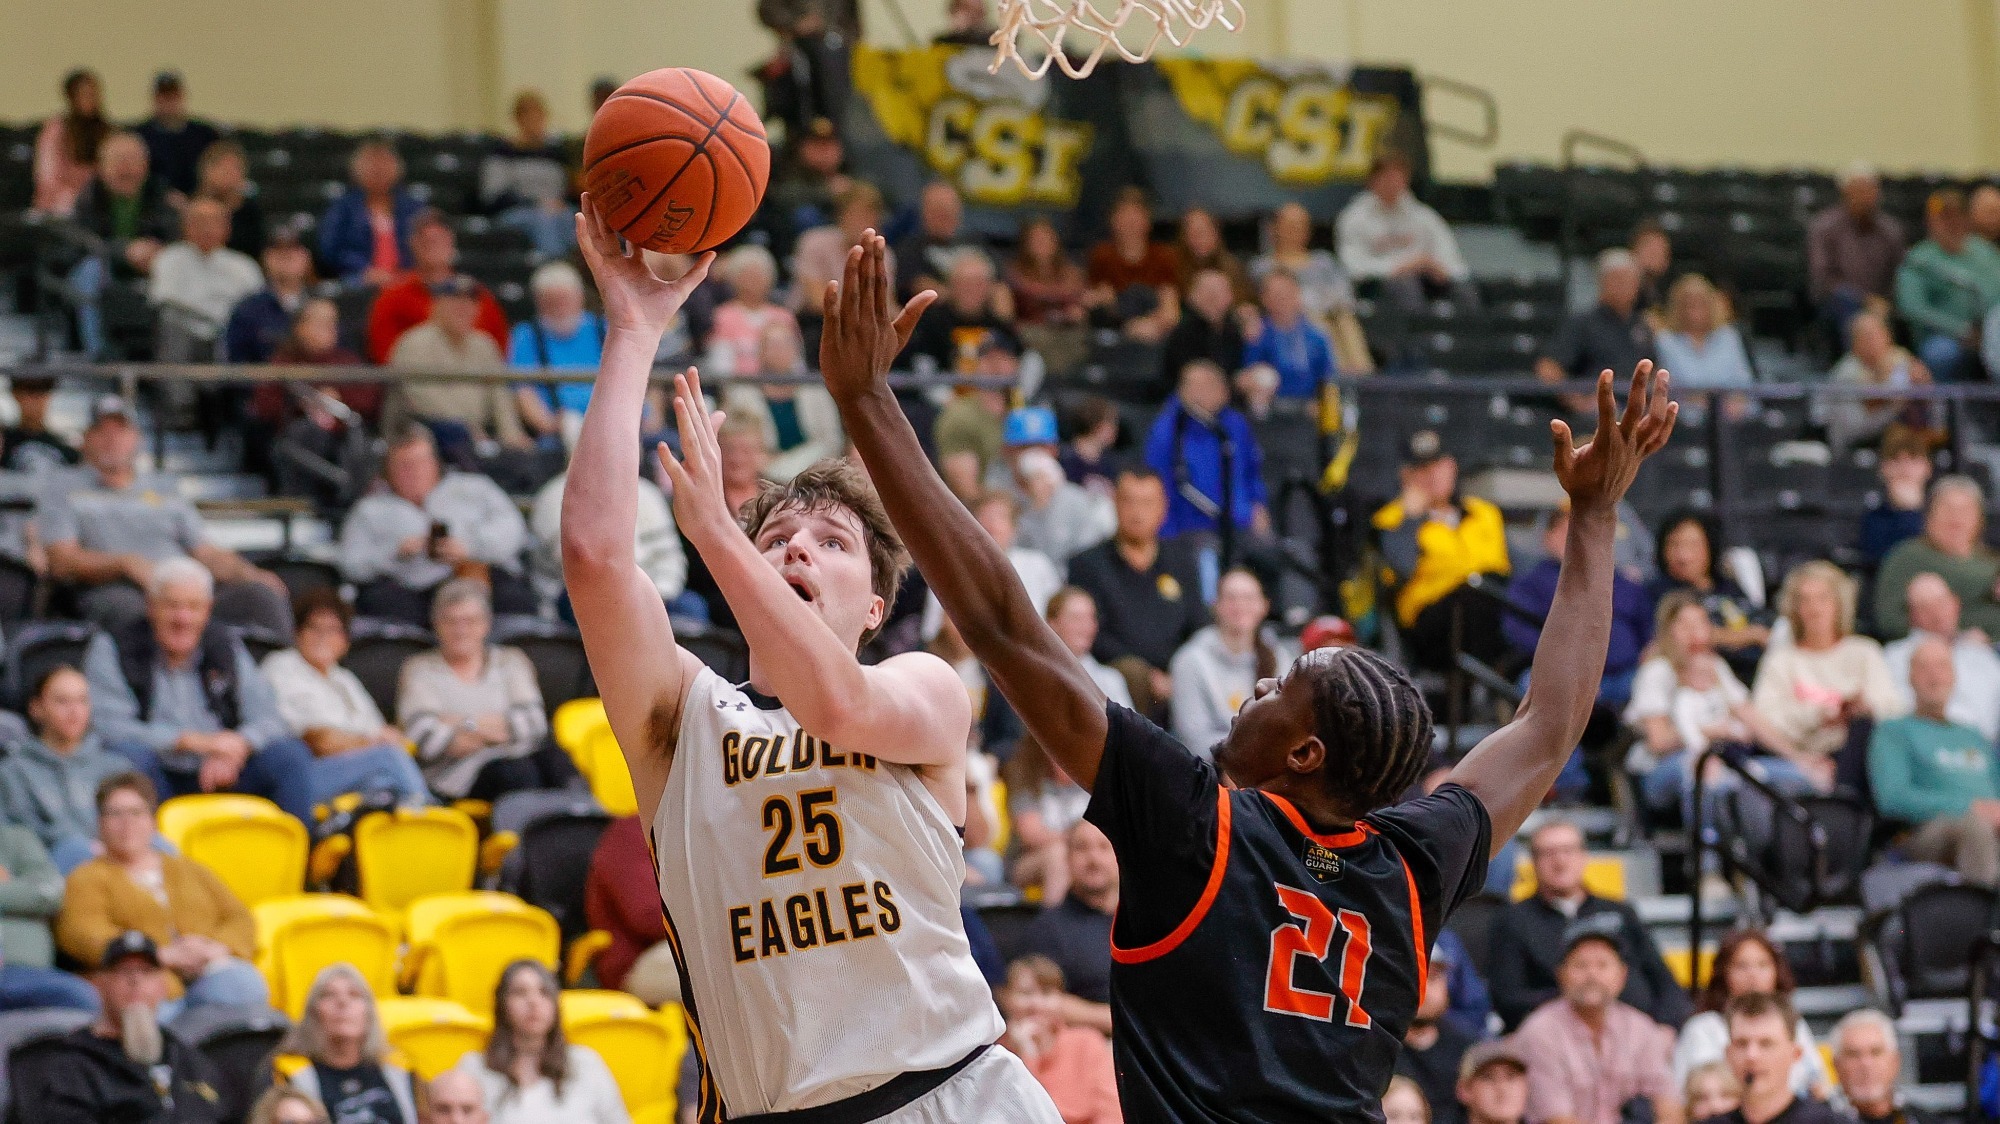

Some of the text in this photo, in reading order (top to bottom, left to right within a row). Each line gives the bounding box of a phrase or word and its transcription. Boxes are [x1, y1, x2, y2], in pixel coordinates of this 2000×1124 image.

[926, 97, 1096, 206] CSI
[1222, 76, 1392, 184] CSI
[761, 786, 845, 879] 25
[1305, 858, 1340, 873] GUARD
[1307, 846, 1339, 861] ARMY
[728, 880, 902, 964] EAGLES
[1263, 881, 1374, 1030] 21
